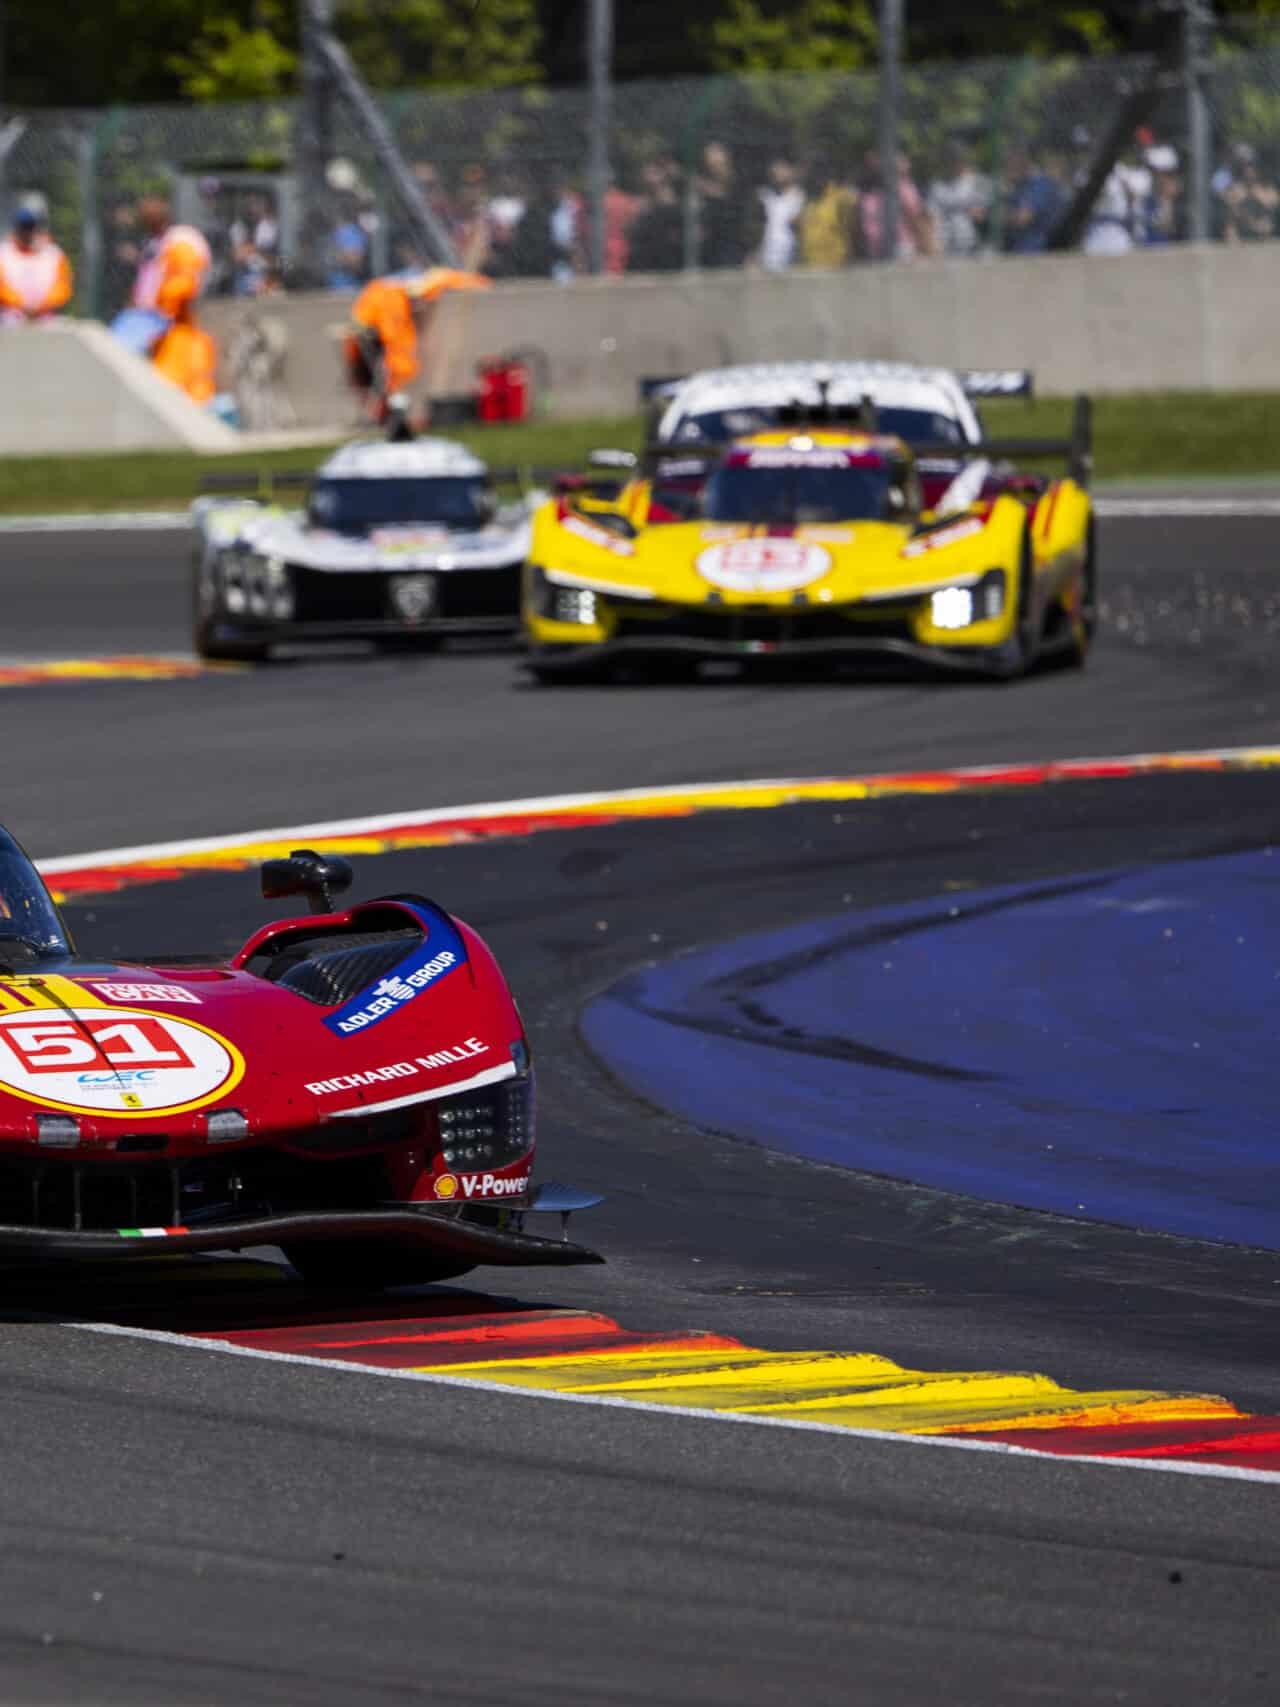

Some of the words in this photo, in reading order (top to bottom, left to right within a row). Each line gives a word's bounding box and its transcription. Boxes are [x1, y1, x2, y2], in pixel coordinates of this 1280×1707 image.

[337, 996, 399, 1033] ADLER
[405, 951, 457, 988] GROUP
[6, 1024, 182, 1067] 51
[304, 1062, 419, 1095] RICHARD
[415, 1037, 490, 1069] MILLE
[77, 1070, 157, 1083] WEC
